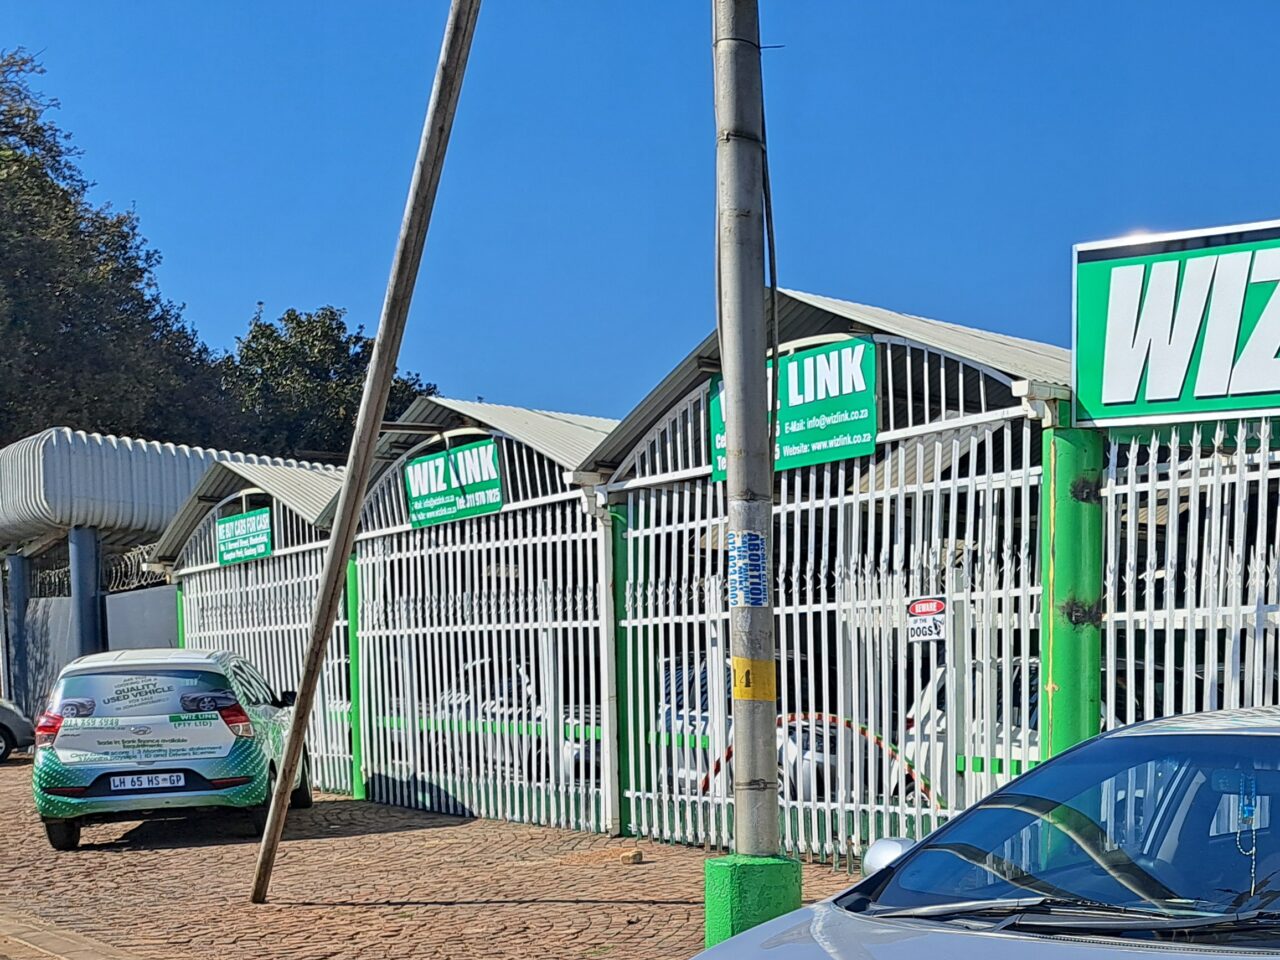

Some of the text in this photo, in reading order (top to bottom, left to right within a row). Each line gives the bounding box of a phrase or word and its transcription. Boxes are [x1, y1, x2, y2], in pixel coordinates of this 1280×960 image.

[788, 344, 866, 407] LINK
[806, 408, 869, 429] info@wizlink.co.za
[783, 443, 810, 456] Website:
[407, 444, 497, 498] WIZ LINK
[748, 533, 762, 606] ABORTION
[910, 626, 933, 638] DOGS
[103, 685, 175, 705] USED VEHICLE
[115, 682, 158, 695] QUALITY
[113, 774, 182, 788] LH 65 HS GP
